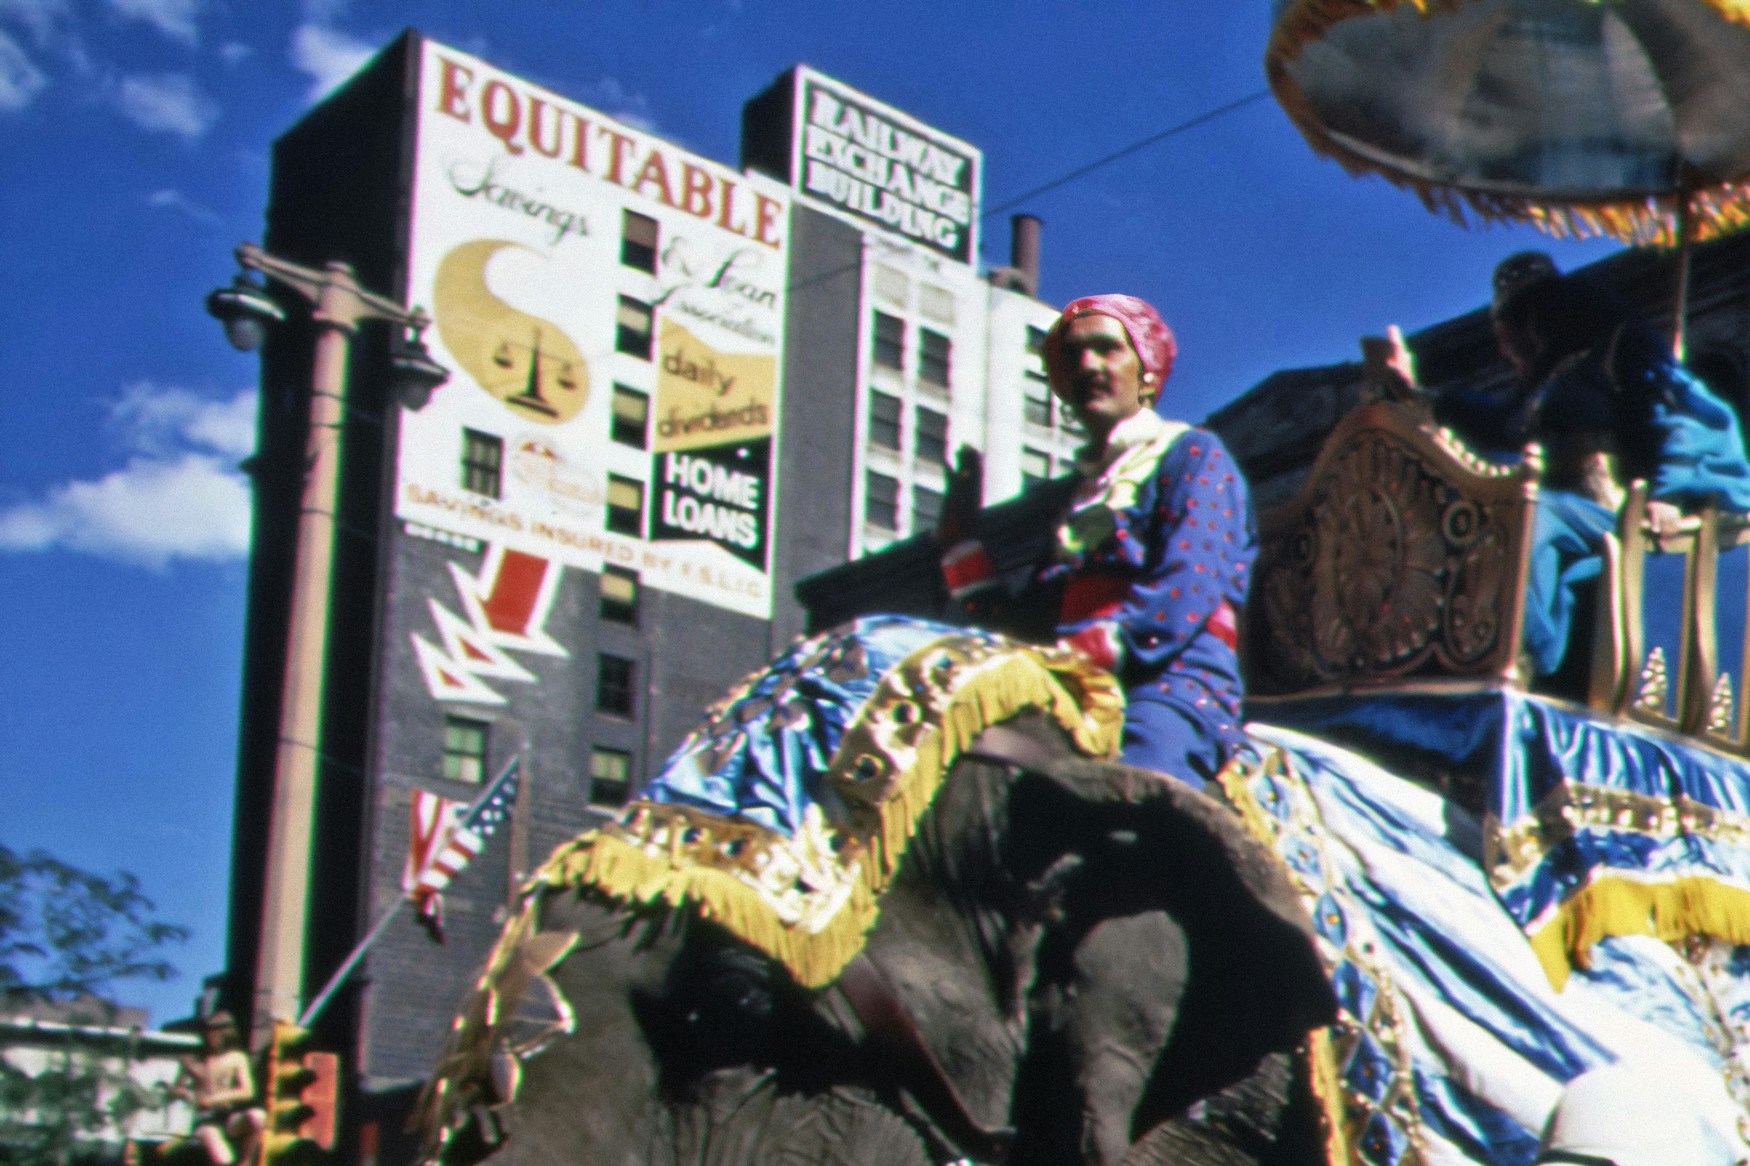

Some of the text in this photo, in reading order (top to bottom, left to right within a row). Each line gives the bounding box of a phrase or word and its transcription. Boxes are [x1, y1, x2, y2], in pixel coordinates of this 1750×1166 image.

[434, 55, 782, 250] EQUITABLE
[811, 90, 965, 186] RAILWAY
[258, 199, 297, 222] NO
[440, 146, 590, 247] Savings
[806, 160, 958, 249] BUILDING
[241, 257, 306, 279] TURN
[243, 228, 304, 250] LEFT
[693, 246, 778, 309] Loan
[662, 346, 736, 397] daily
[656, 397, 768, 439] dividends
[665, 450, 760, 510] HOME
[405, 483, 524, 531] SAVINGS
[529, 520, 635, 562] INSURED
[640, 550, 672, 572] BY
[662, 488, 758, 550] LOANS
